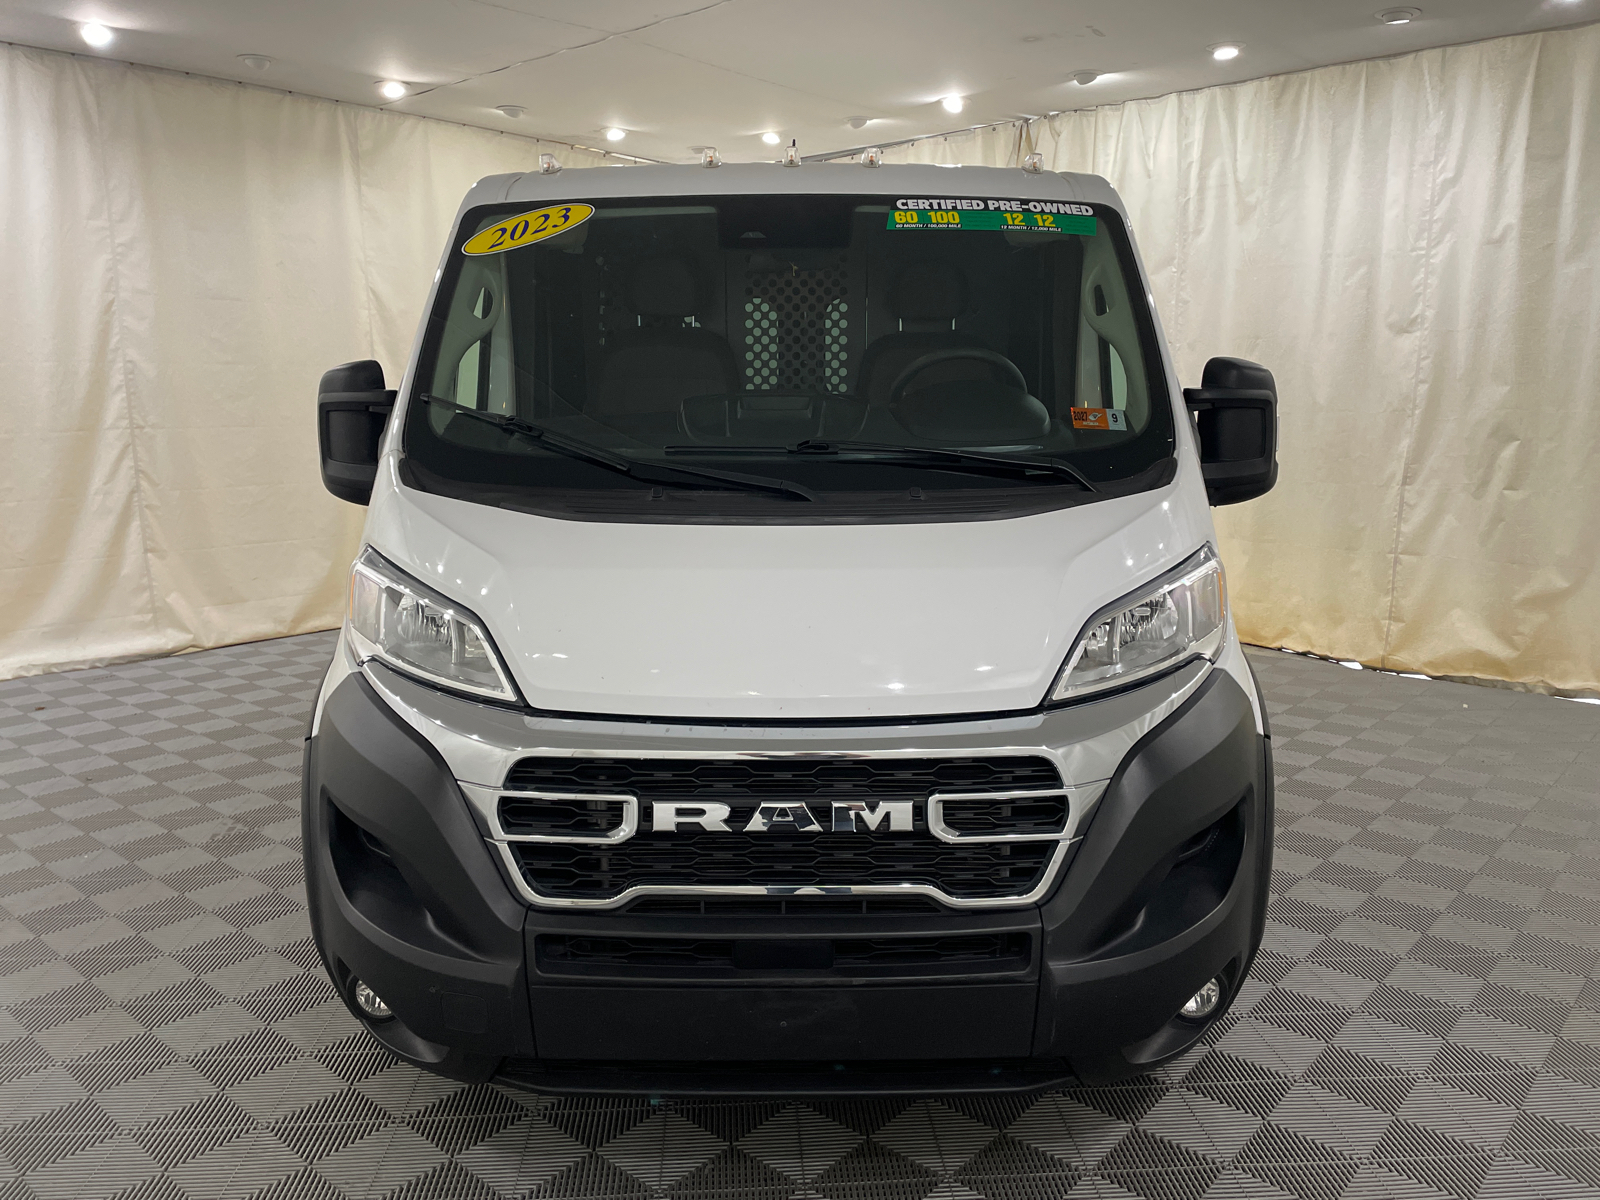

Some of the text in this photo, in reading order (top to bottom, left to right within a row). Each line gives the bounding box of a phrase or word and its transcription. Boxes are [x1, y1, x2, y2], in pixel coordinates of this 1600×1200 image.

[896, 199, 1094, 216] CERTIFIED PRE-OWNED
[894, 211, 918, 223] 60
[927, 211, 960, 224] 100
[1003, 213, 1026, 226] 12
[1033, 214, 1056, 227] 12
[487, 207, 572, 250] 2023
[1073, 410, 1119, 423] 2027 9
[651, 801, 914, 832] RAM
